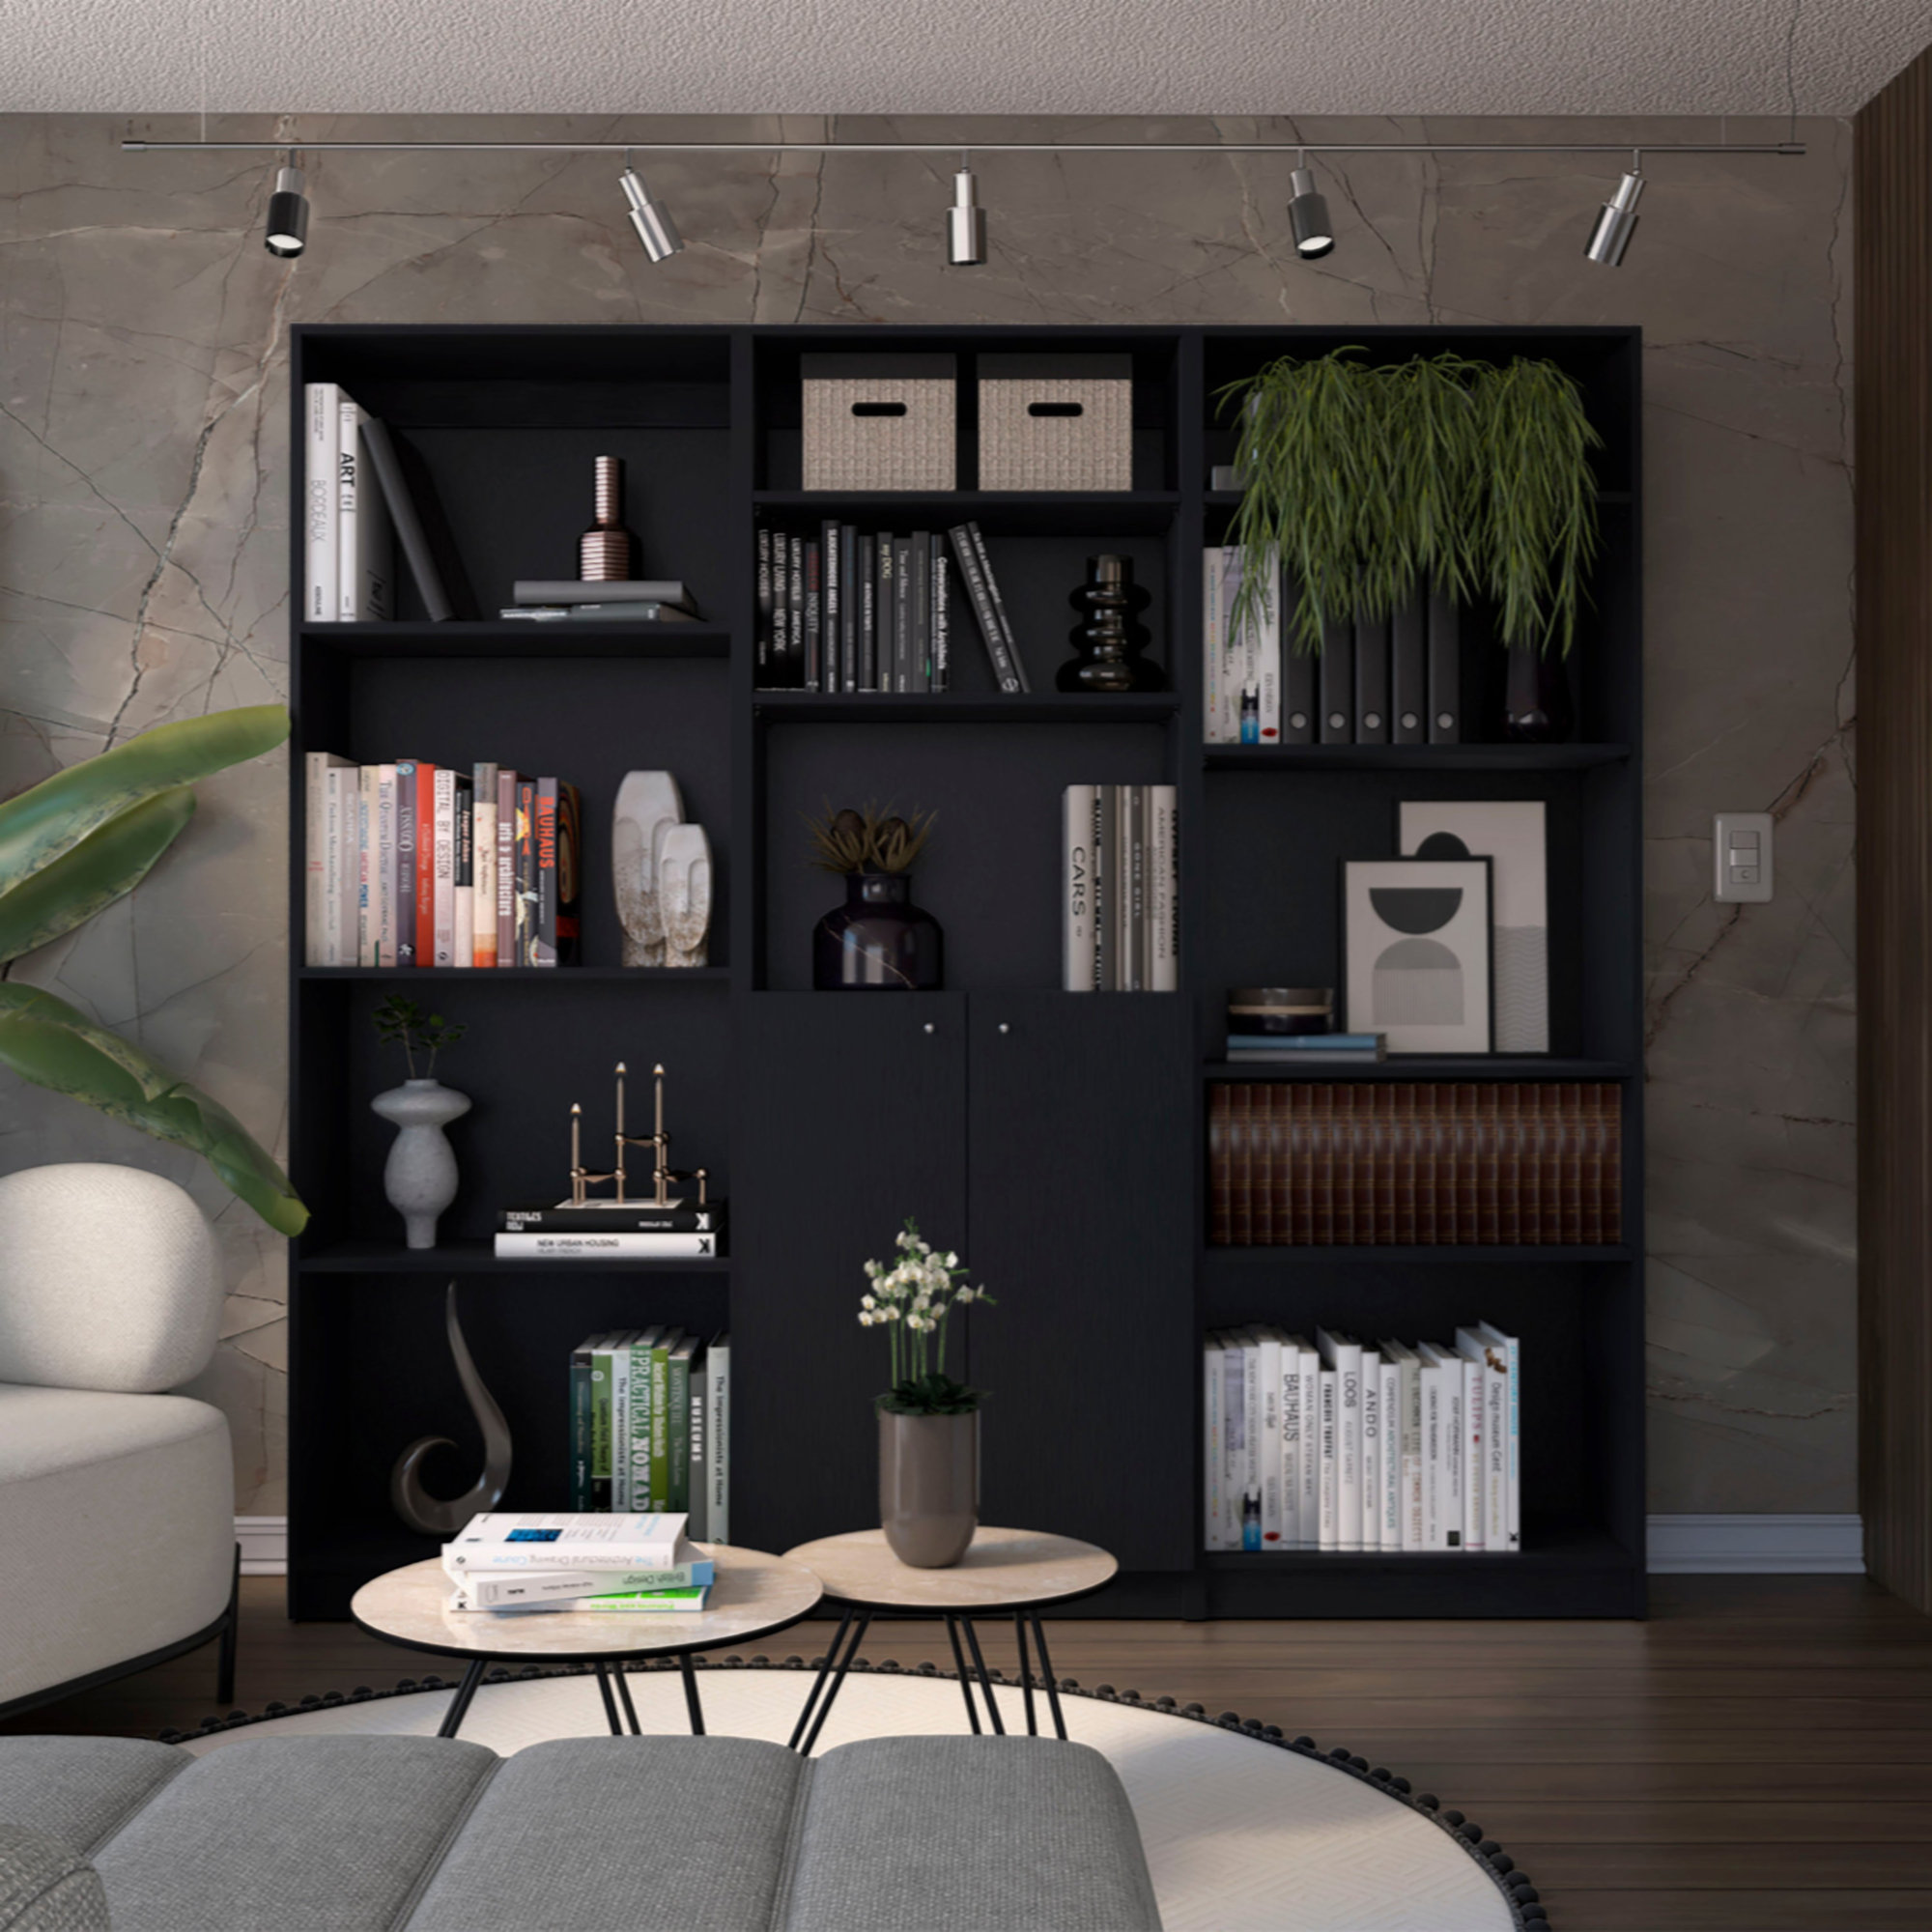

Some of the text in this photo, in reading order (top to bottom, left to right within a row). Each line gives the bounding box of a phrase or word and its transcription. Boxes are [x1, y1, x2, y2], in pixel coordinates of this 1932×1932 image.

[340, 452, 355, 488] ART
[310, 480, 327, 543] BORDEAUX
[758, 528, 768, 561] LUXURY
[791, 537, 802, 569] LUXURY
[882, 556, 892, 579] DOG
[773, 532, 786, 652] LUXURY LIVING NEW YORK
[791, 610, 802, 645] AMERICA
[437, 771, 451, 879] DIGITAL BY DESIGN
[498, 821, 513, 840] arts
[538, 796, 554, 867] BAUHAUS
[360, 883, 369, 907] POWER
[498, 856, 513, 916] architecture
[1071, 846, 1086, 916] CARS
[1284, 1374, 1299, 1441] BAUHAUS
[1305, 1375, 1314, 1411] WOMAN
[1344, 1371, 1357, 1408] LOOS
[1472, 1376, 1483, 1430] TULIPS
[1490, 1382, 1502, 1411] Design
[631, 1356, 650, 1511] PRACTICAL NOMAD
[691, 1397, 701, 1462] MUSEUMS
[1305, 1414, 1314, 1439] ONLY
[1366, 1389, 1377, 1438] ANDO
[1490, 1413, 1502, 1448] museum
[616, 1378, 627, 1505] The Impressionists at Home
[714, 1376, 724, 1507] The Impressionists at Home
[1386, 1429, 1396, 1489] ARCHITECTURAL
[493, 1553, 654, 1567] The Architectural Drawing Course
[622, 1573, 655, 1586] Design
